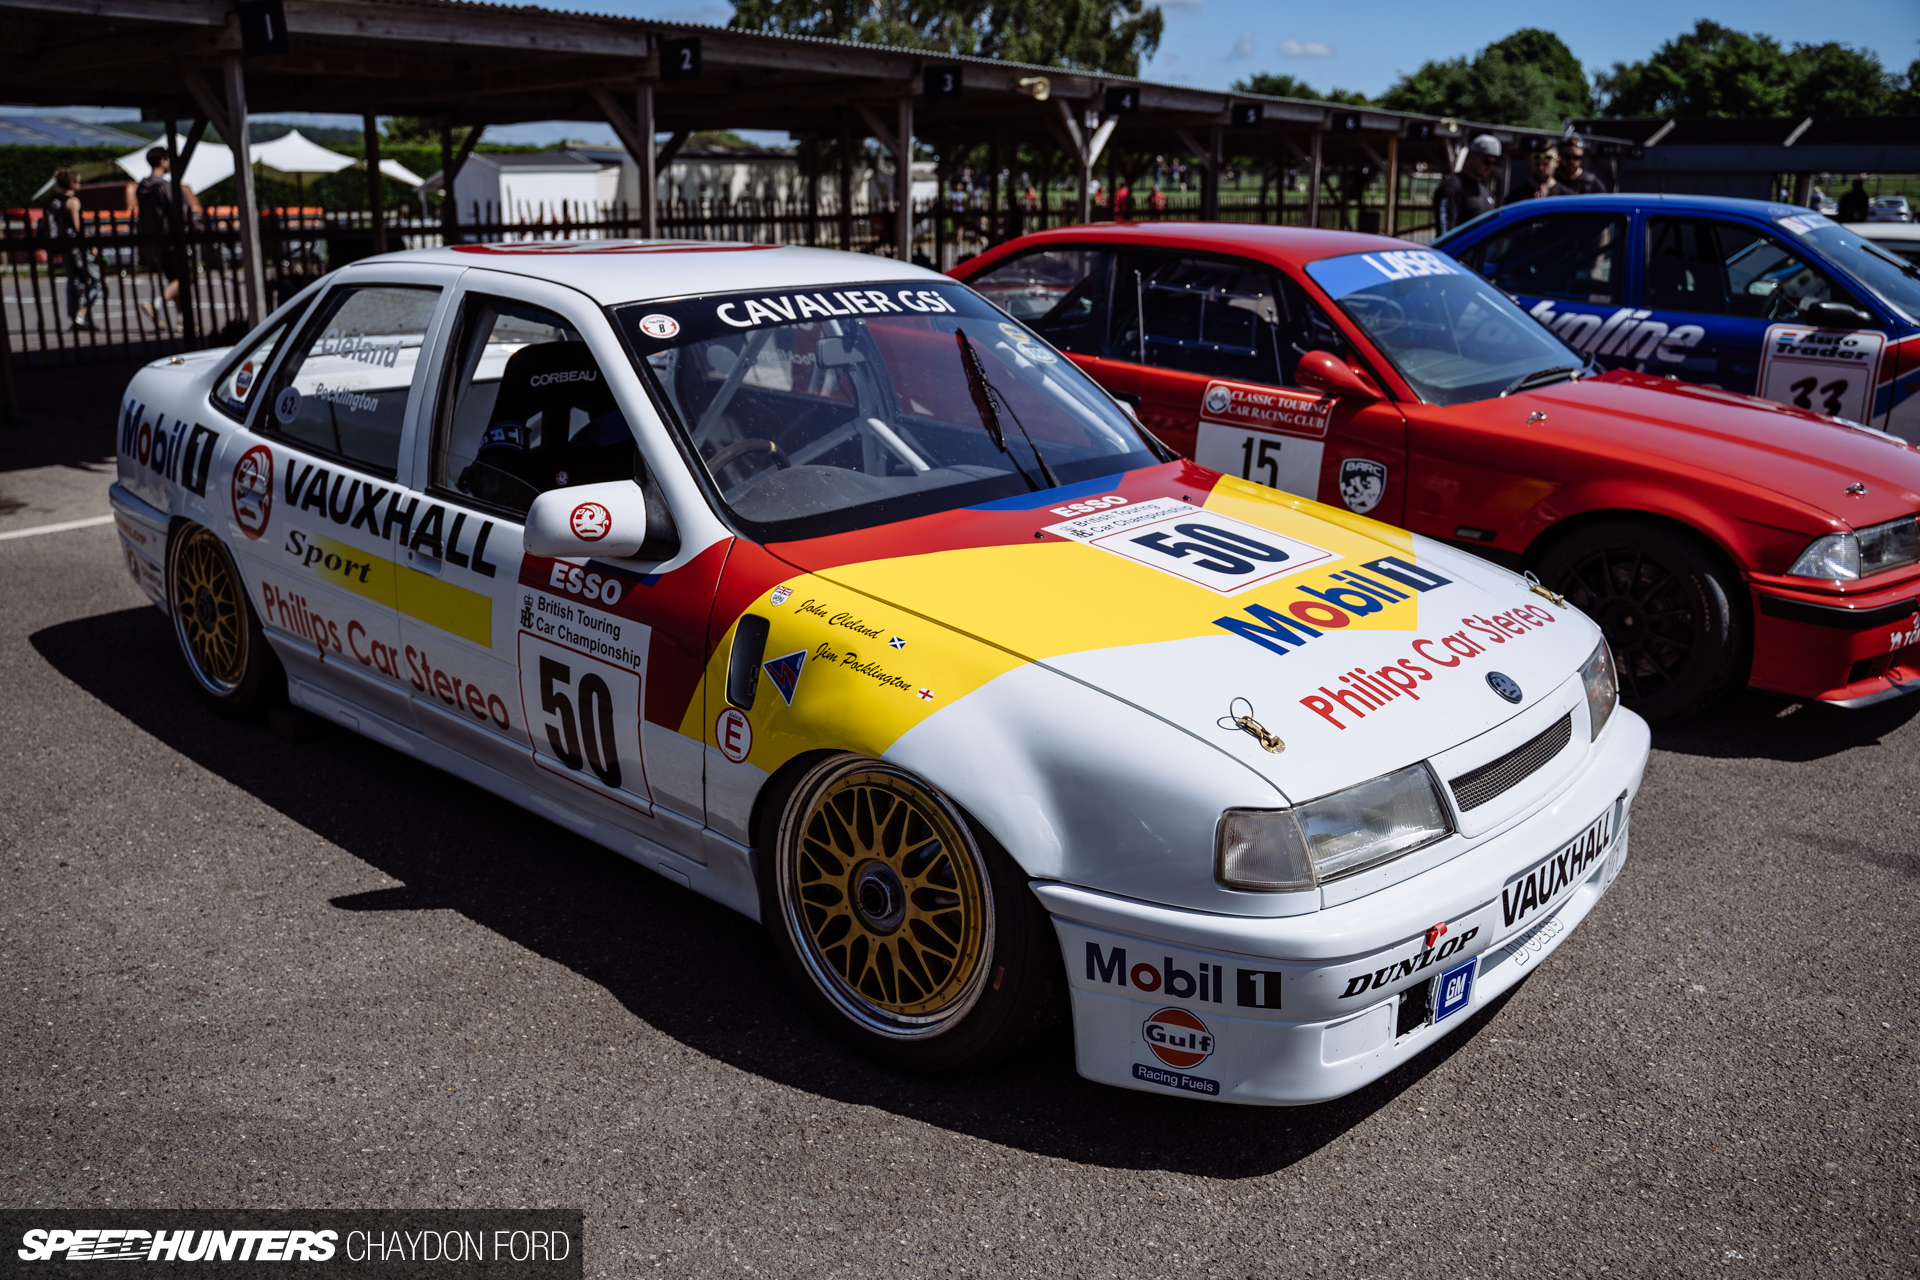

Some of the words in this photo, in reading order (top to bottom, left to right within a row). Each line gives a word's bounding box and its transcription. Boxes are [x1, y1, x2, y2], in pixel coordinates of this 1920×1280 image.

[680, 49, 692, 71] 2
[942, 73, 953, 92] 3
[1120, 94, 1132, 109] 4
[1361, 250, 1459, 281] LASER
[716, 290, 903, 328] CAVALIER
[898, 290, 957, 314] GSi
[658, 323, 666, 334] B
[1799, 333, 1859, 348] Auto
[321, 328, 404, 368] Cleland
[1776, 342, 1870, 360] Trader
[314, 382, 379, 412] Pocklington
[530, 370, 597, 387] CORBEAU
[1790, 376, 1848, 417] 33
[281, 396, 296, 416] 62
[1227, 403, 1251, 416] CAR
[1251, 406, 1293, 424] RACING
[1294, 412, 1325, 429] CLUB
[1231, 390, 1276, 406] CLASSIC
[1278, 397, 1329, 415] TOURING
[121, 398, 188, 483] Mobil
[1241, 436, 1282, 490] 15
[1345, 461, 1383, 477] BARC
[284, 459, 497, 579] VAUXHALL
[1049, 495, 1129, 518] ESSO
[1072, 511, 1114, 528] British
[1113, 503, 1161, 518] Touring
[1090, 524, 1111, 533] Car
[1112, 505, 1193, 528] Championship
[284, 530, 372, 584] Sport
[1128, 523, 1290, 575] 50
[549, 562, 622, 605] ESSO
[537, 595, 574, 622] British
[577, 609, 621, 641] Touring
[794, 599, 828, 618] John
[828, 612, 885, 639] Cleland
[1211, 569, 1412, 657] Mobil
[261, 581, 343, 663] Philips
[347, 620, 401, 680] Car
[404, 645, 510, 731] Stereo
[536, 616, 555, 636] Car
[557, 624, 641, 669] Championship
[811, 642, 838, 662] Jim
[840, 652, 912, 692] Pocklington
[1299, 658, 1433, 731] Philips
[1411, 630, 1487, 668] Car
[1460, 604, 1556, 644] Stereo
[539, 655, 622, 789] 50
[725, 716, 744, 755] E
[1501, 811, 1610, 928] VAUXHALL
[1086, 941, 1223, 1004] Mobil
[1338, 926, 1480, 1000] DUNLOP
[1445, 972, 1468, 1001] GM
[1145, 1024, 1212, 1052] Gulf
[1138, 1065, 1179, 1087] Racing
[1181, 1076, 1214, 1092] Fuels
